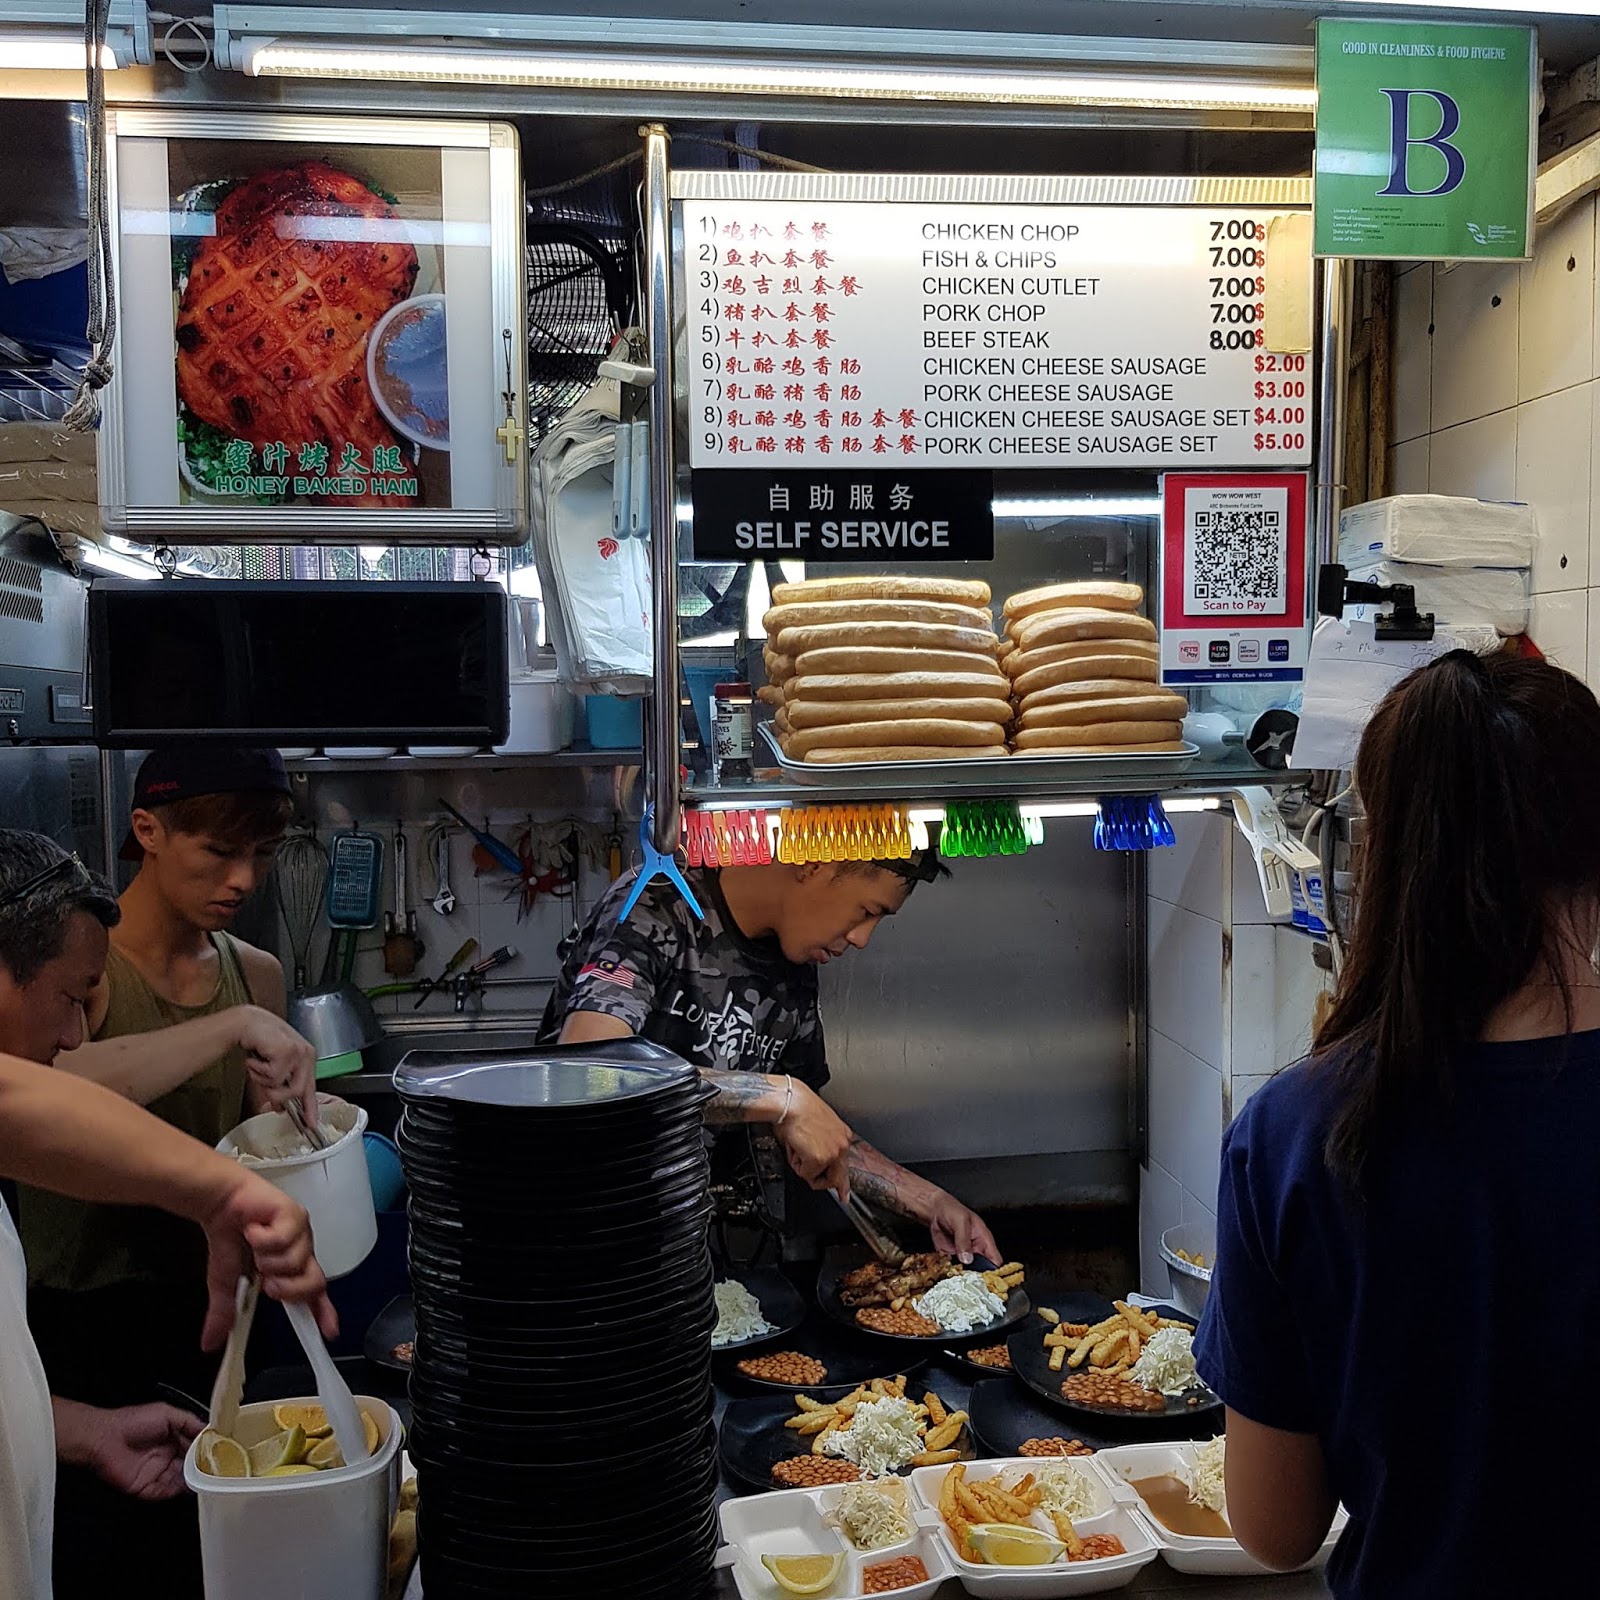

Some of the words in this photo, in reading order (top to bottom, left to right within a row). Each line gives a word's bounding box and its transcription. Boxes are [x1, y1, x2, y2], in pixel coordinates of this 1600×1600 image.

[1342, 42, 1367, 54] GOOD
[1369, 43, 1378, 55] IN
[1379, 43, 1435, 57] CLEANLINESS
[1437, 47, 1444, 57] &
[1445, 46, 1469, 58] FOOD
[1471, 47, 1506, 60] HYGIENE
[1375, 88, 1467, 198] B
[700, 217, 717, 237] 1)
[922, 223, 1014, 241] CHICKEN
[1020, 224, 1080, 242] CHOP
[699, 244, 718, 265] 2)
[722, 248, 835, 270] 鱼扒套餐
[922, 250, 968, 268] FISH
[975, 250, 989, 268] &
[994, 250, 1057, 269] CHIPS
[700, 271, 719, 292] 3)
[922, 277, 1014, 295] CHICKEN
[1021, 277, 1101, 296] CUTLET
[700, 298, 720, 320] 4)
[723, 301, 836, 323] 猪扒套餐
[923, 304, 981, 322] PORK
[987, 304, 1046, 322] CHOP
[701, 325, 721, 347] 5)
[724, 328, 837, 350] 牛扒套餐
[923, 331, 976, 348] BEEF
[983, 331, 1050, 348] STEAK
[702, 352, 722, 374] 6)
[725, 355, 862, 377] 乳酪鸡香肠
[923, 358, 1015, 375] CHICKEN
[1022, 358, 1105, 375] CHEESE
[1110, 357, 1207, 375] SAUSAGE
[1254, 355, 1305, 373] $2.00
[703, 379, 722, 401] 7)
[725, 382, 862, 403] 乳酪猪香肠
[923, 384, 982, 402] PORK
[988, 384, 1071, 402] CHEESE
[1077, 384, 1174, 401] SAUSAGE
[1254, 381, 1305, 399] $3.00
[704, 405, 723, 427] 8)
[726, 407, 922, 429] 乳酪鸡香肠套餐
[923, 410, 1016, 428] CHICKEN
[1022, 410, 1105, 428] CHEESE
[1110, 410, 1207, 427] SAUSAGE
[1213, 409, 1251, 427] SET
[1254, 407, 1304, 425] $4.00
[704, 432, 724, 454] 9)
[727, 433, 923, 455] 乳酪猪香肠套餐
[924, 437, 983, 454] PORK
[988, 436, 1071, 454] CHEESE
[1077, 436, 1174, 453] SAUSAGE
[1180, 435, 1219, 452] SET
[1254, 432, 1304, 451] $5.00
[225, 439, 408, 476] 蜜汁烤火腿
[216, 476, 289, 495] HONEY
[294, 477, 367, 495] BAKED
[372, 478, 418, 497] HAM
[768, 483, 914, 512] 自助服务
[735, 522, 811, 549] SELF
[820, 520, 949, 548] SERVICE
[1203, 600, 1229, 610] Scan
[1233, 601, 1244, 610] to
[1247, 600, 1266, 612] Pay
